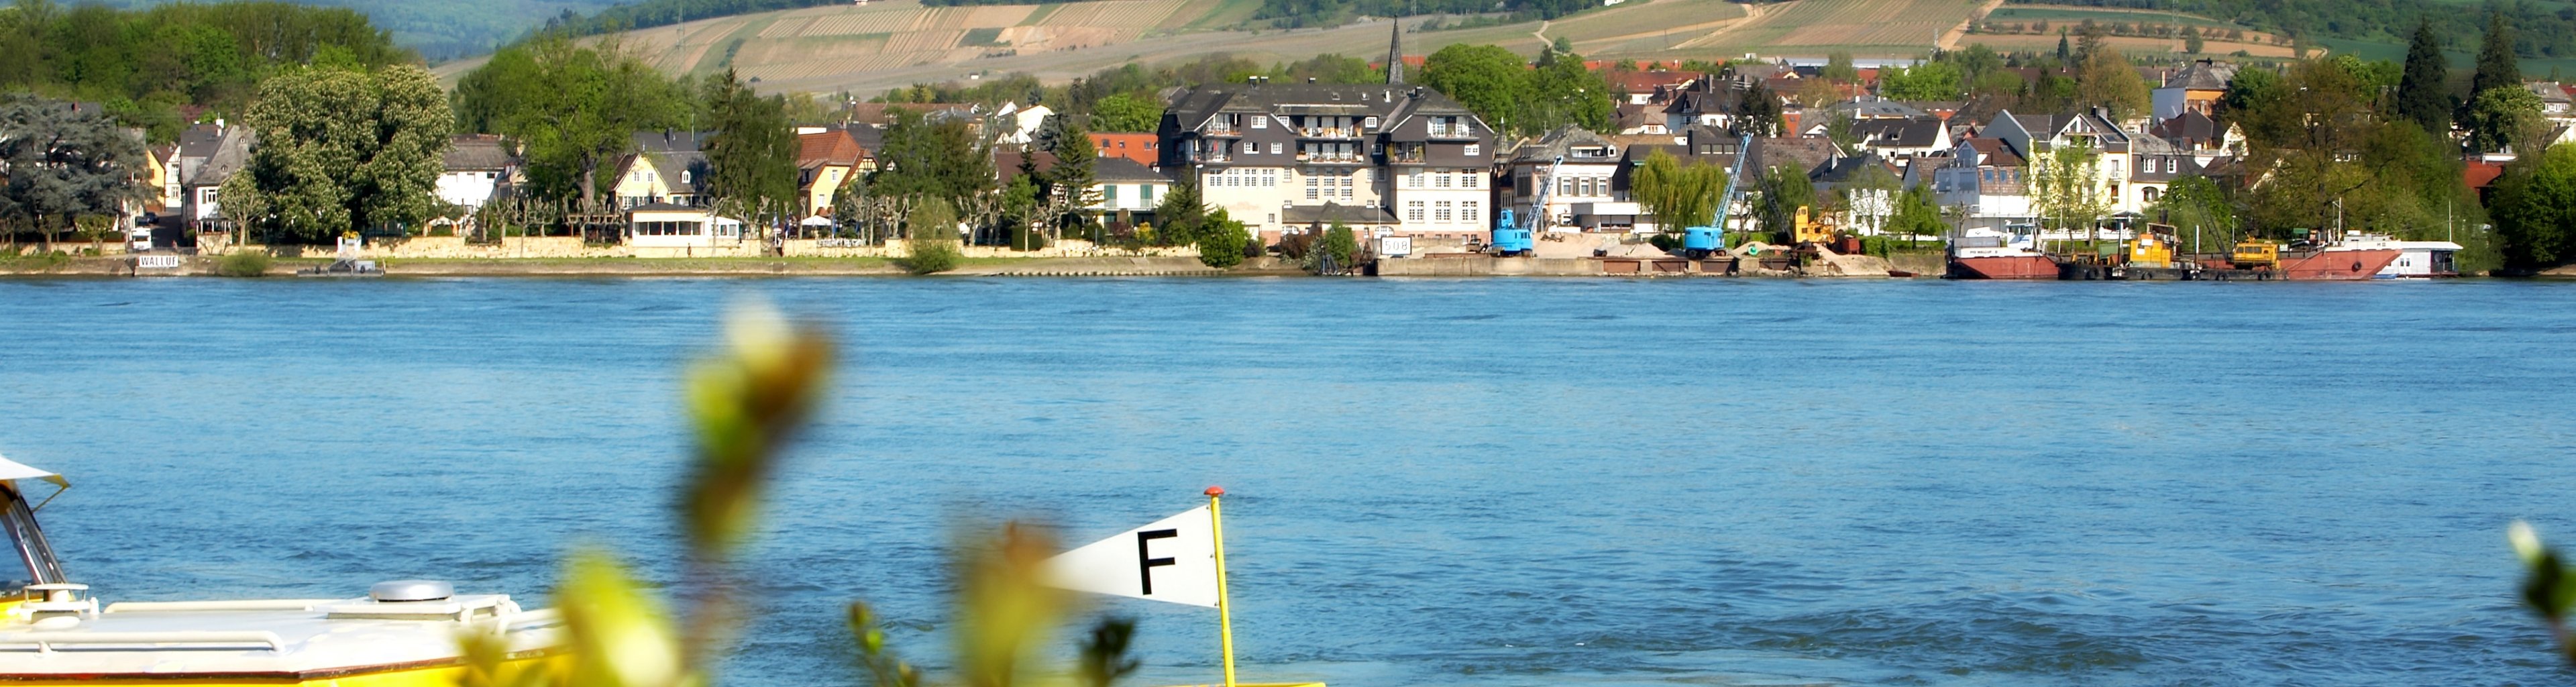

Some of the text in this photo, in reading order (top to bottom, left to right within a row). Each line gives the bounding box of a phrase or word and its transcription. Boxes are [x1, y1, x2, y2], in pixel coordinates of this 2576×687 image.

[1385, 240, 1407, 251] 508
[141, 256, 176, 266] WALLUF
[1137, 528, 1178, 595] F
